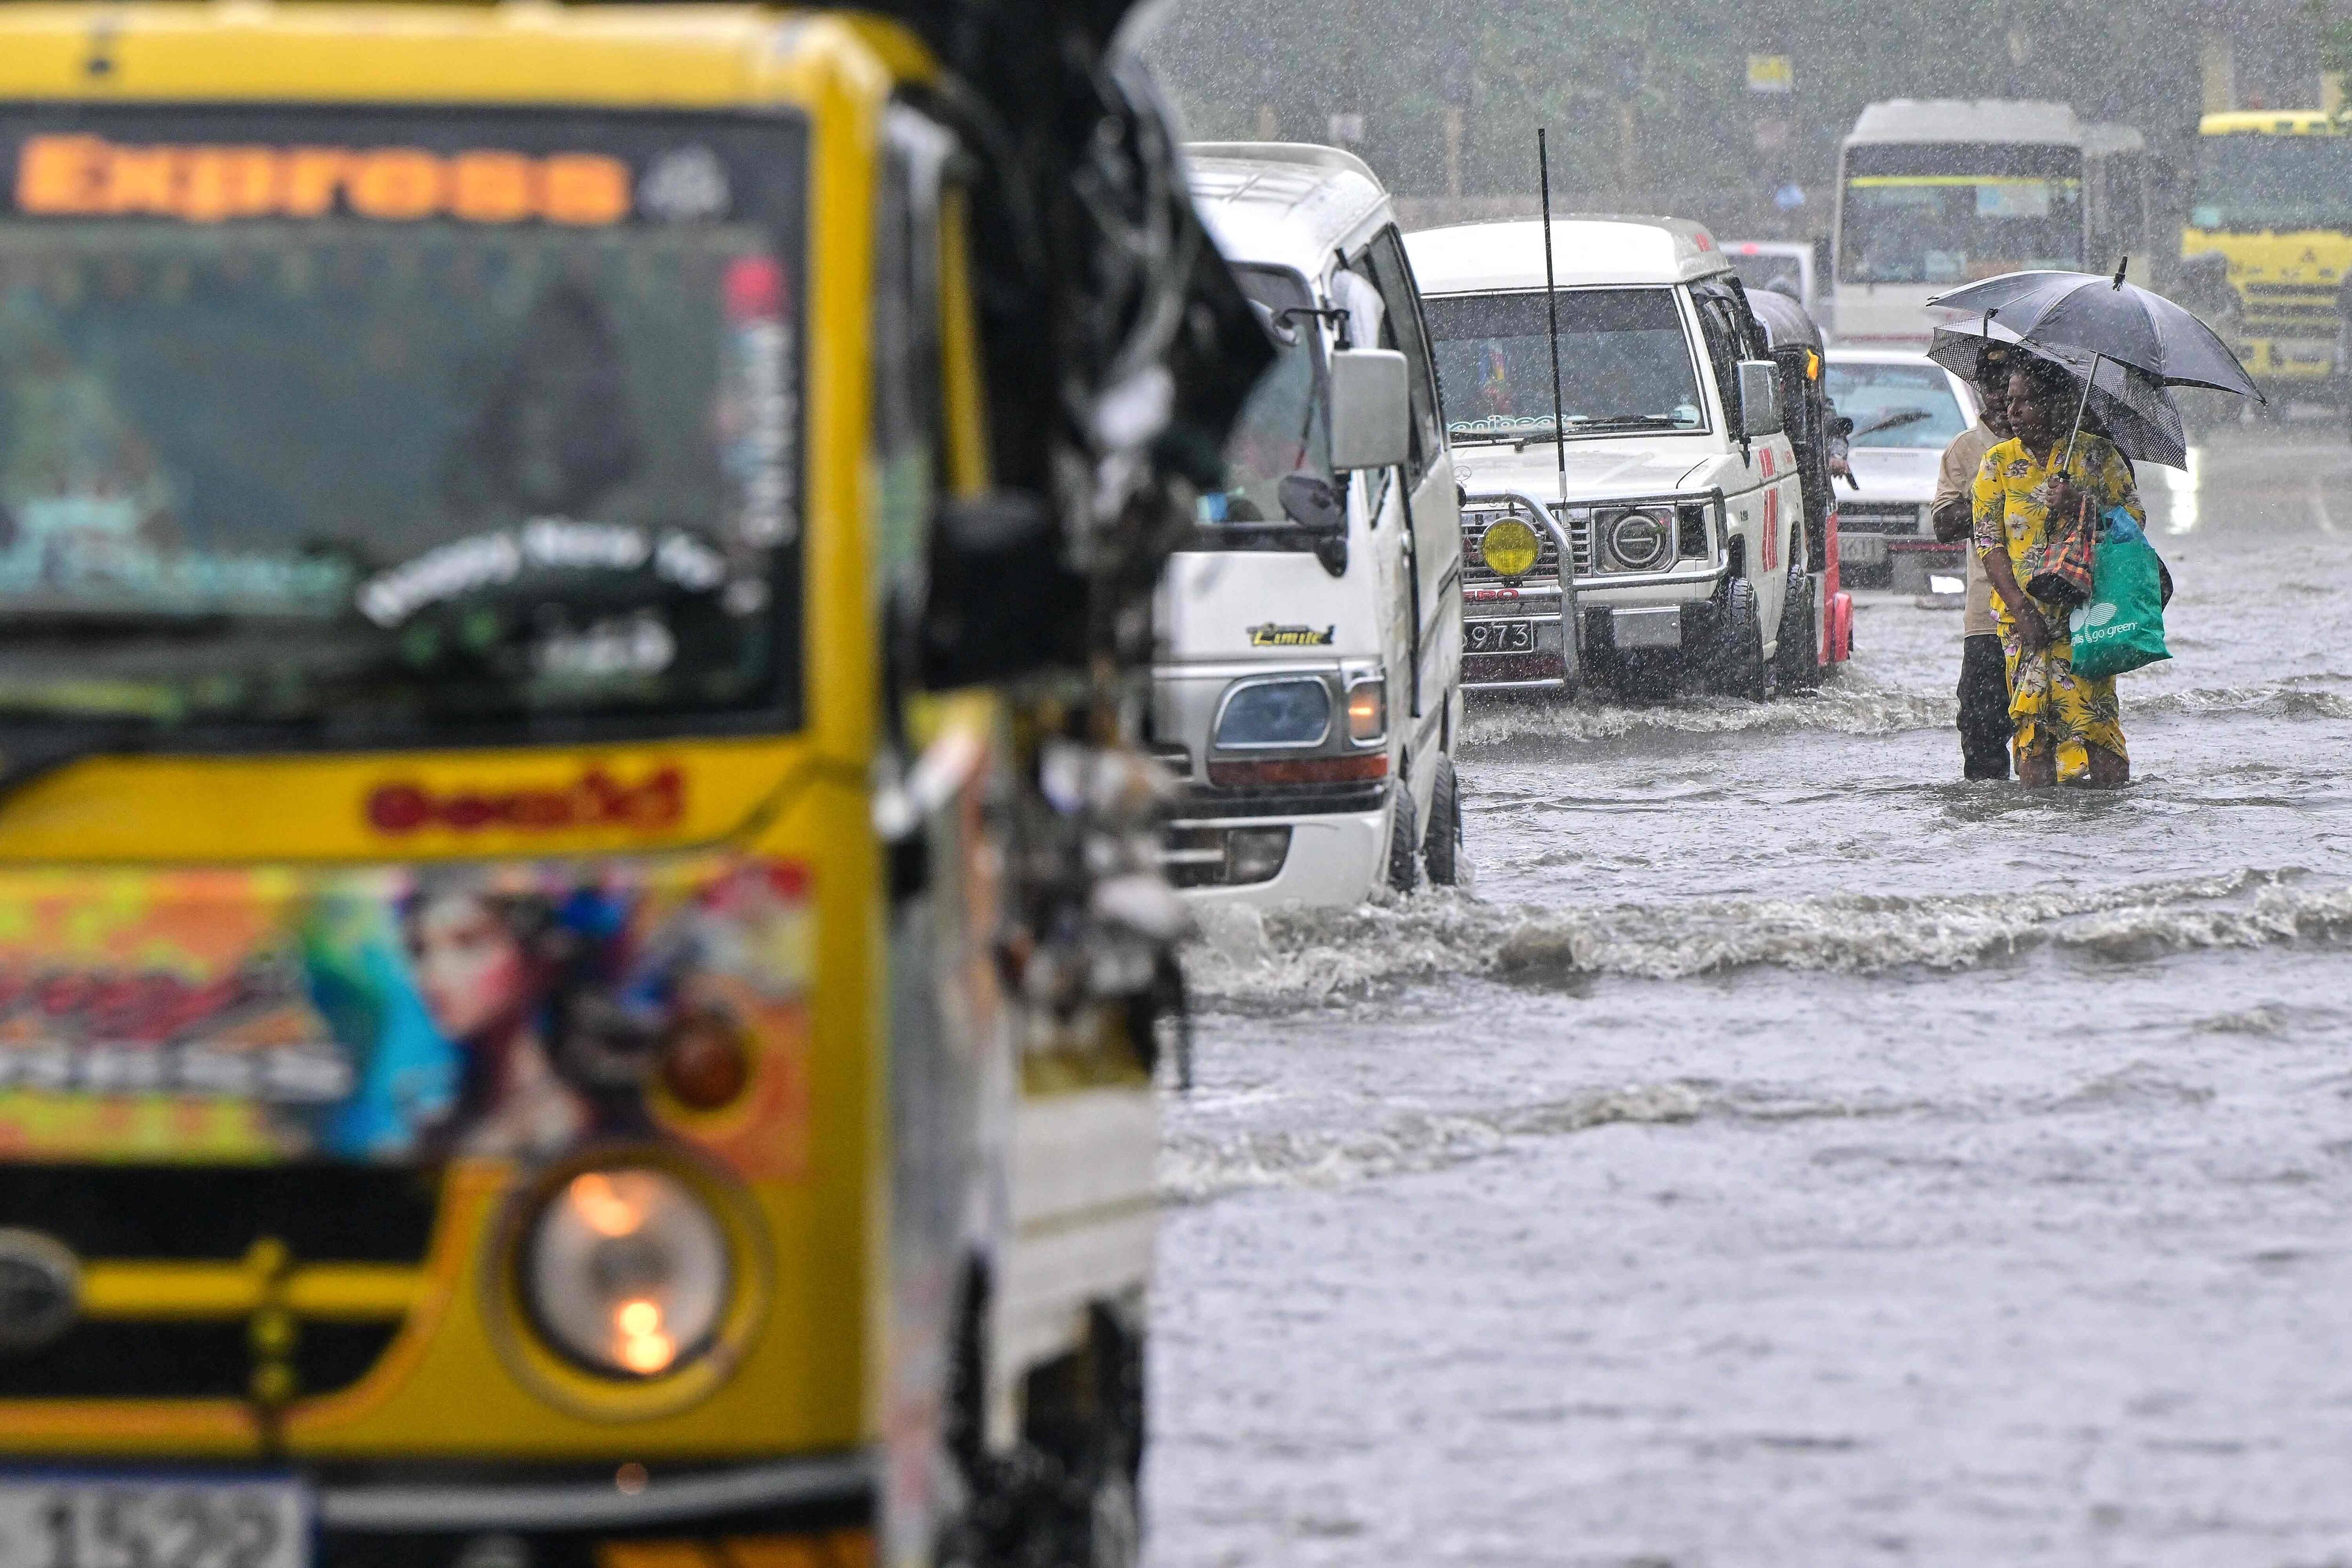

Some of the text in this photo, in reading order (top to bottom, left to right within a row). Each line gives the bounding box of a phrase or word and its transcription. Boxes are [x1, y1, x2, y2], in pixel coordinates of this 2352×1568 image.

[18, 134, 630, 223] Express
[1463, 589, 1519, 602] ERO
[2071, 634, 2084, 646] gills
[2092, 622, 2136, 643] go green
